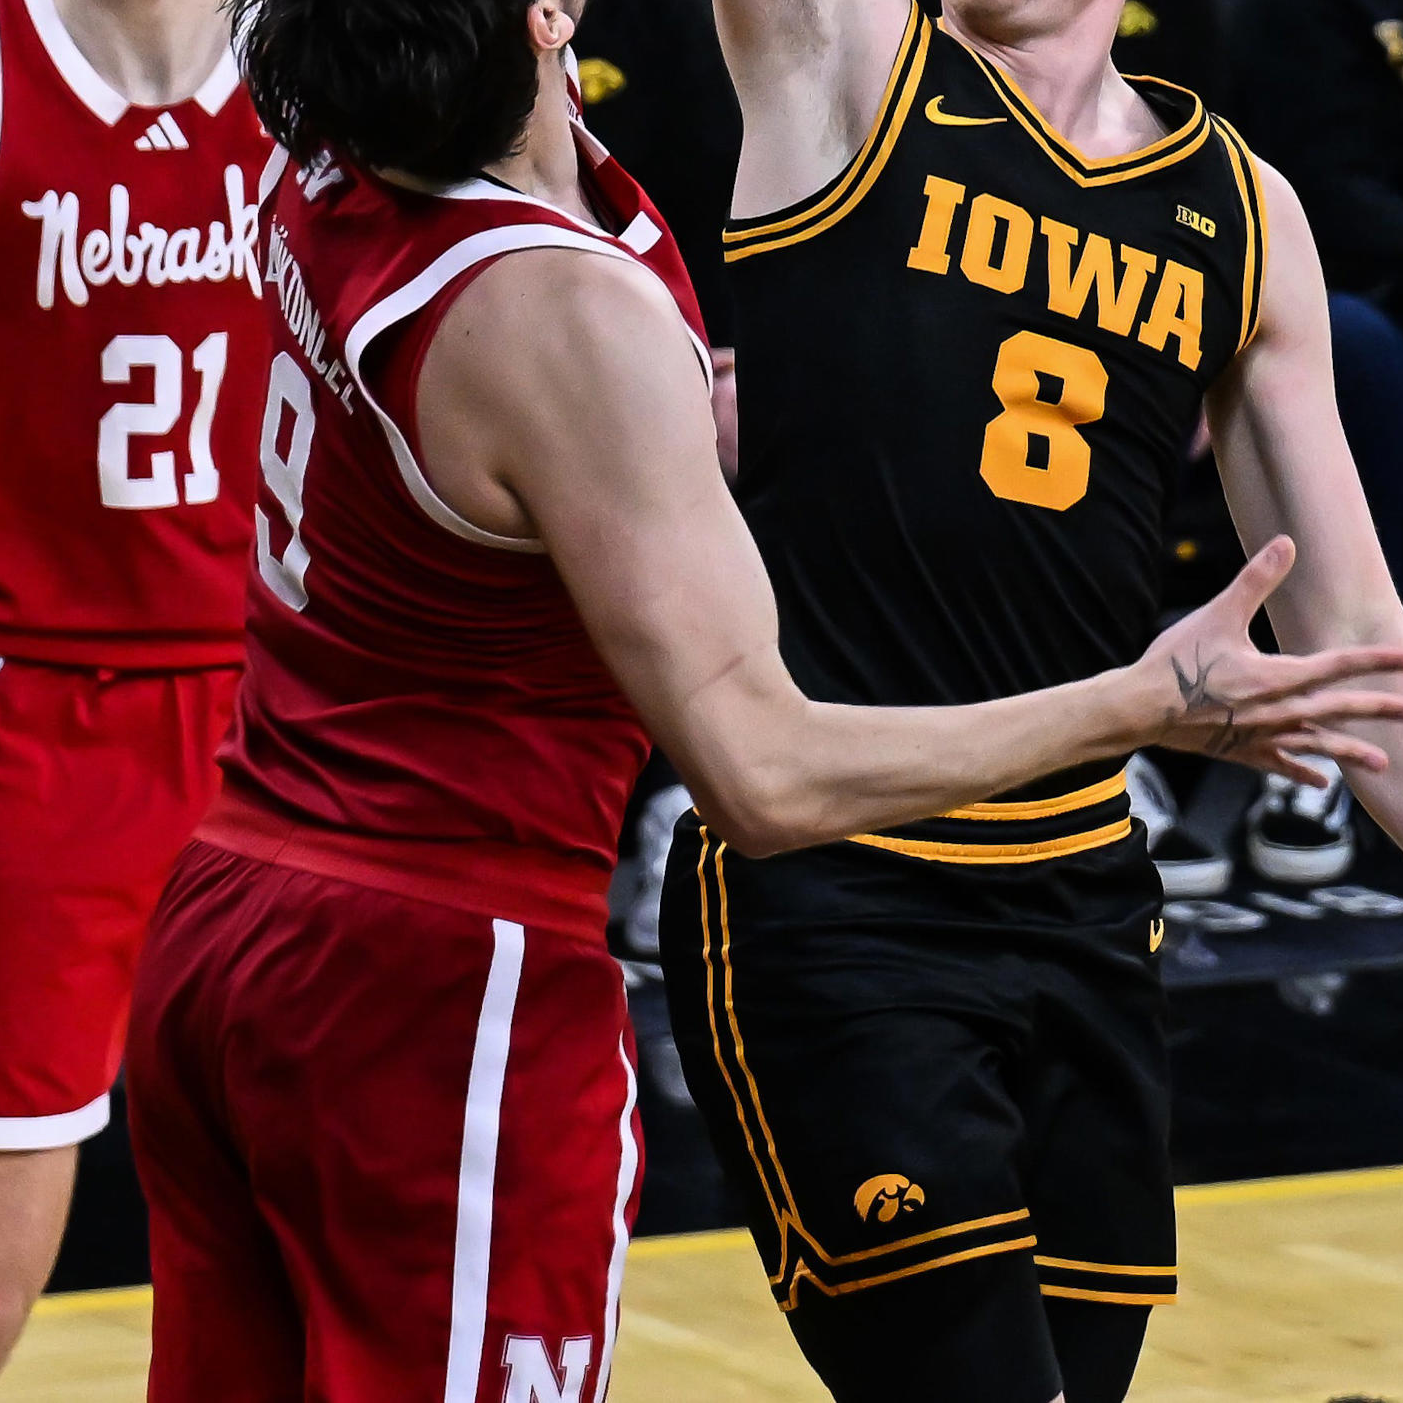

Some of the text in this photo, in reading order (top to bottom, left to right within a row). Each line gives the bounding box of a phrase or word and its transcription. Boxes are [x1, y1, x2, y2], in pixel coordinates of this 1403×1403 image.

[20, 163, 264, 310] Nebrask
[907, 174, 1204, 371] IOWA
[98, 332, 229, 510] 21
[979, 330, 1109, 512] 8
